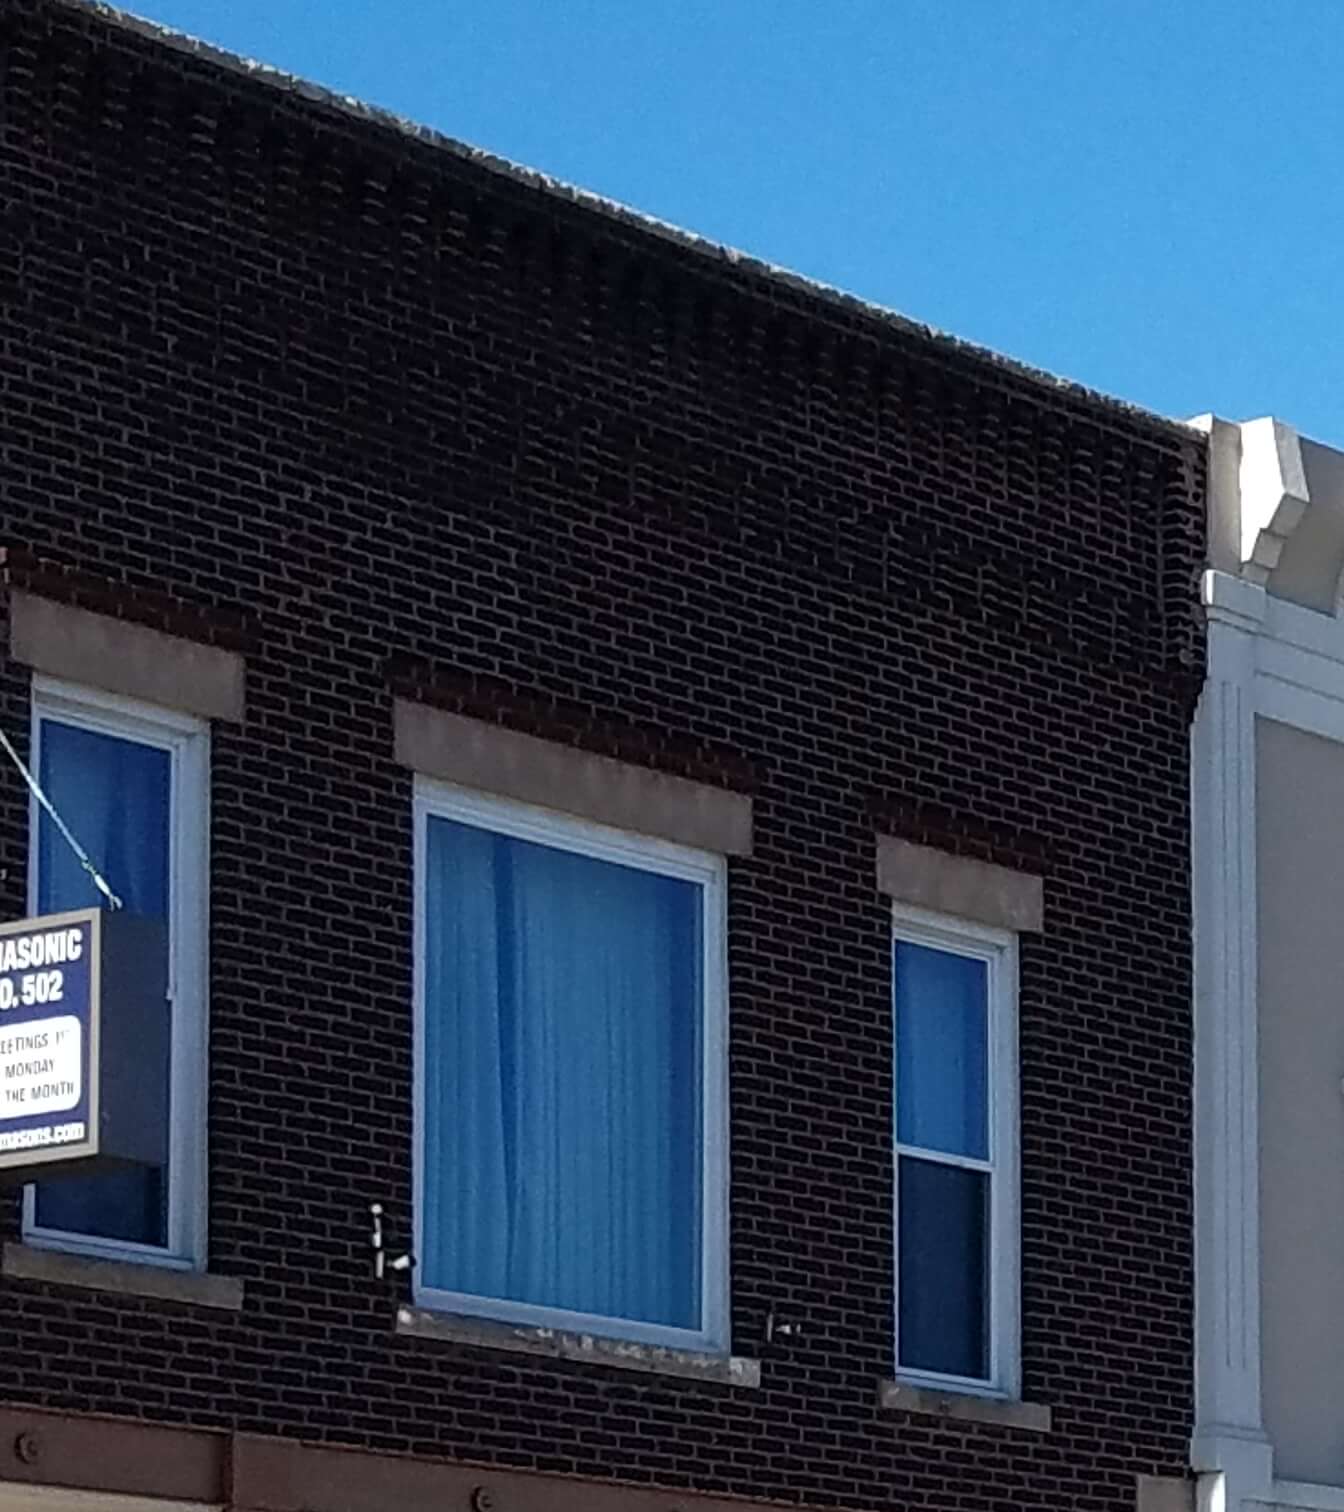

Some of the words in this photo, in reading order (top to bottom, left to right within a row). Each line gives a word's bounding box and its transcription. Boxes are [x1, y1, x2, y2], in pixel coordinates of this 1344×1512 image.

[0, 929, 82, 972] ASONIC
[22, 969, 63, 1006] 502
[5, 1058, 55, 1079] MONDAY
[6, 1087, 26, 1102] THE
[31, 1081, 74, 1100] MONTH
